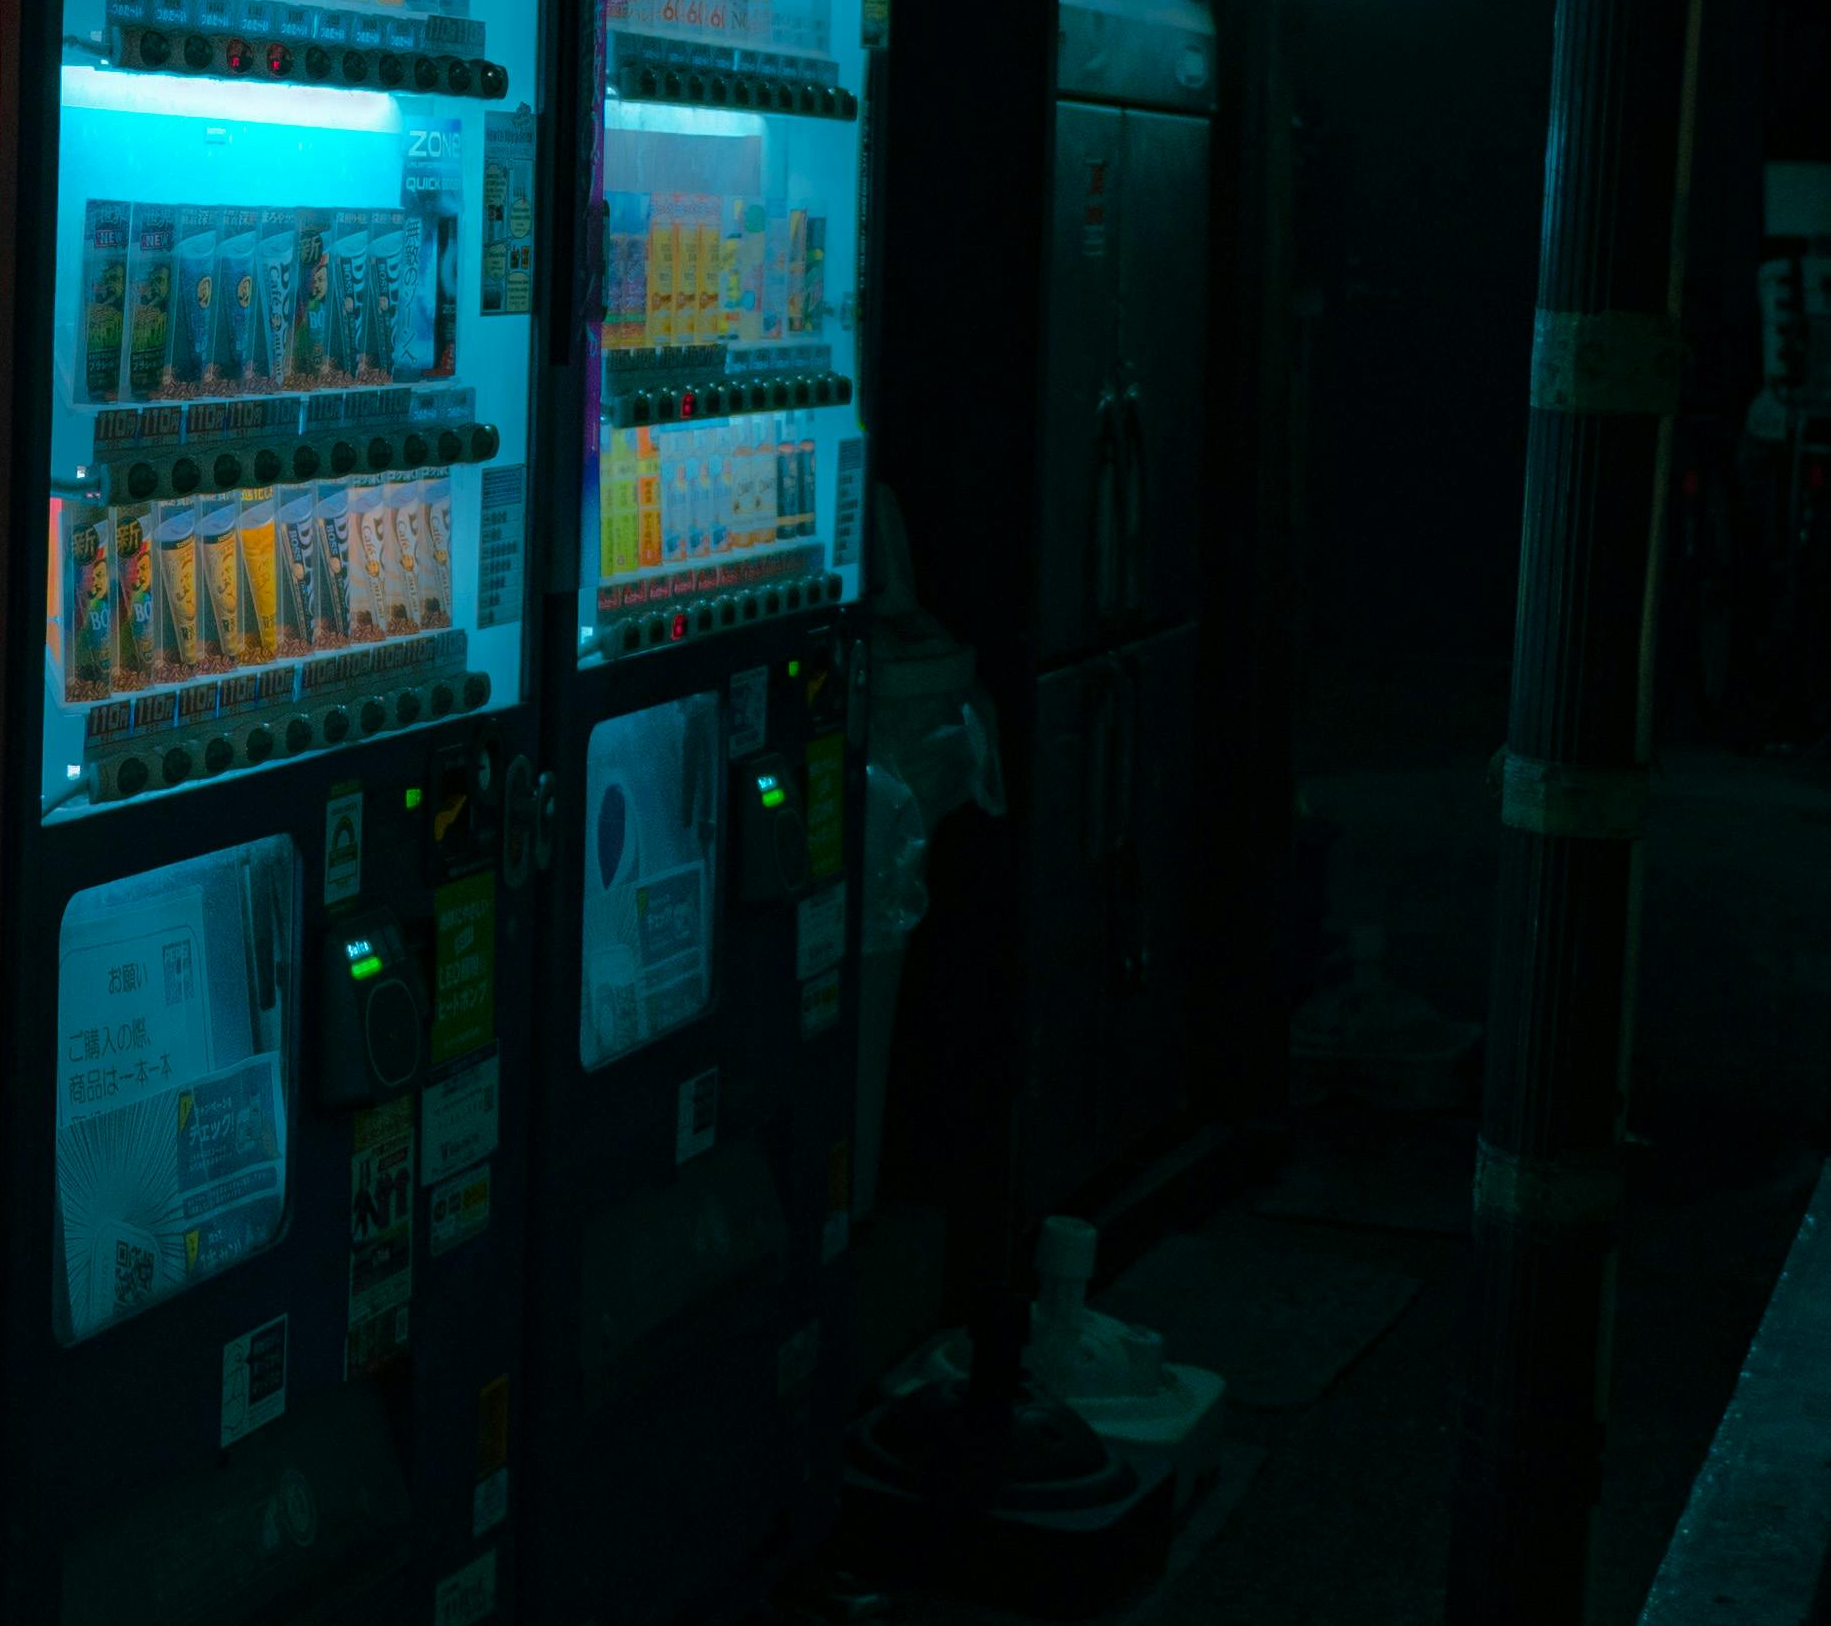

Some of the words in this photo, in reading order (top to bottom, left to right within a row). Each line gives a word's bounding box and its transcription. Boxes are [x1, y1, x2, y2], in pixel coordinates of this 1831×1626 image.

[107, 962, 148, 996] お願い
[67, 1017, 155, 1063] ご購入の際、
[71, 1050, 171, 1106] 商品は一本一本
